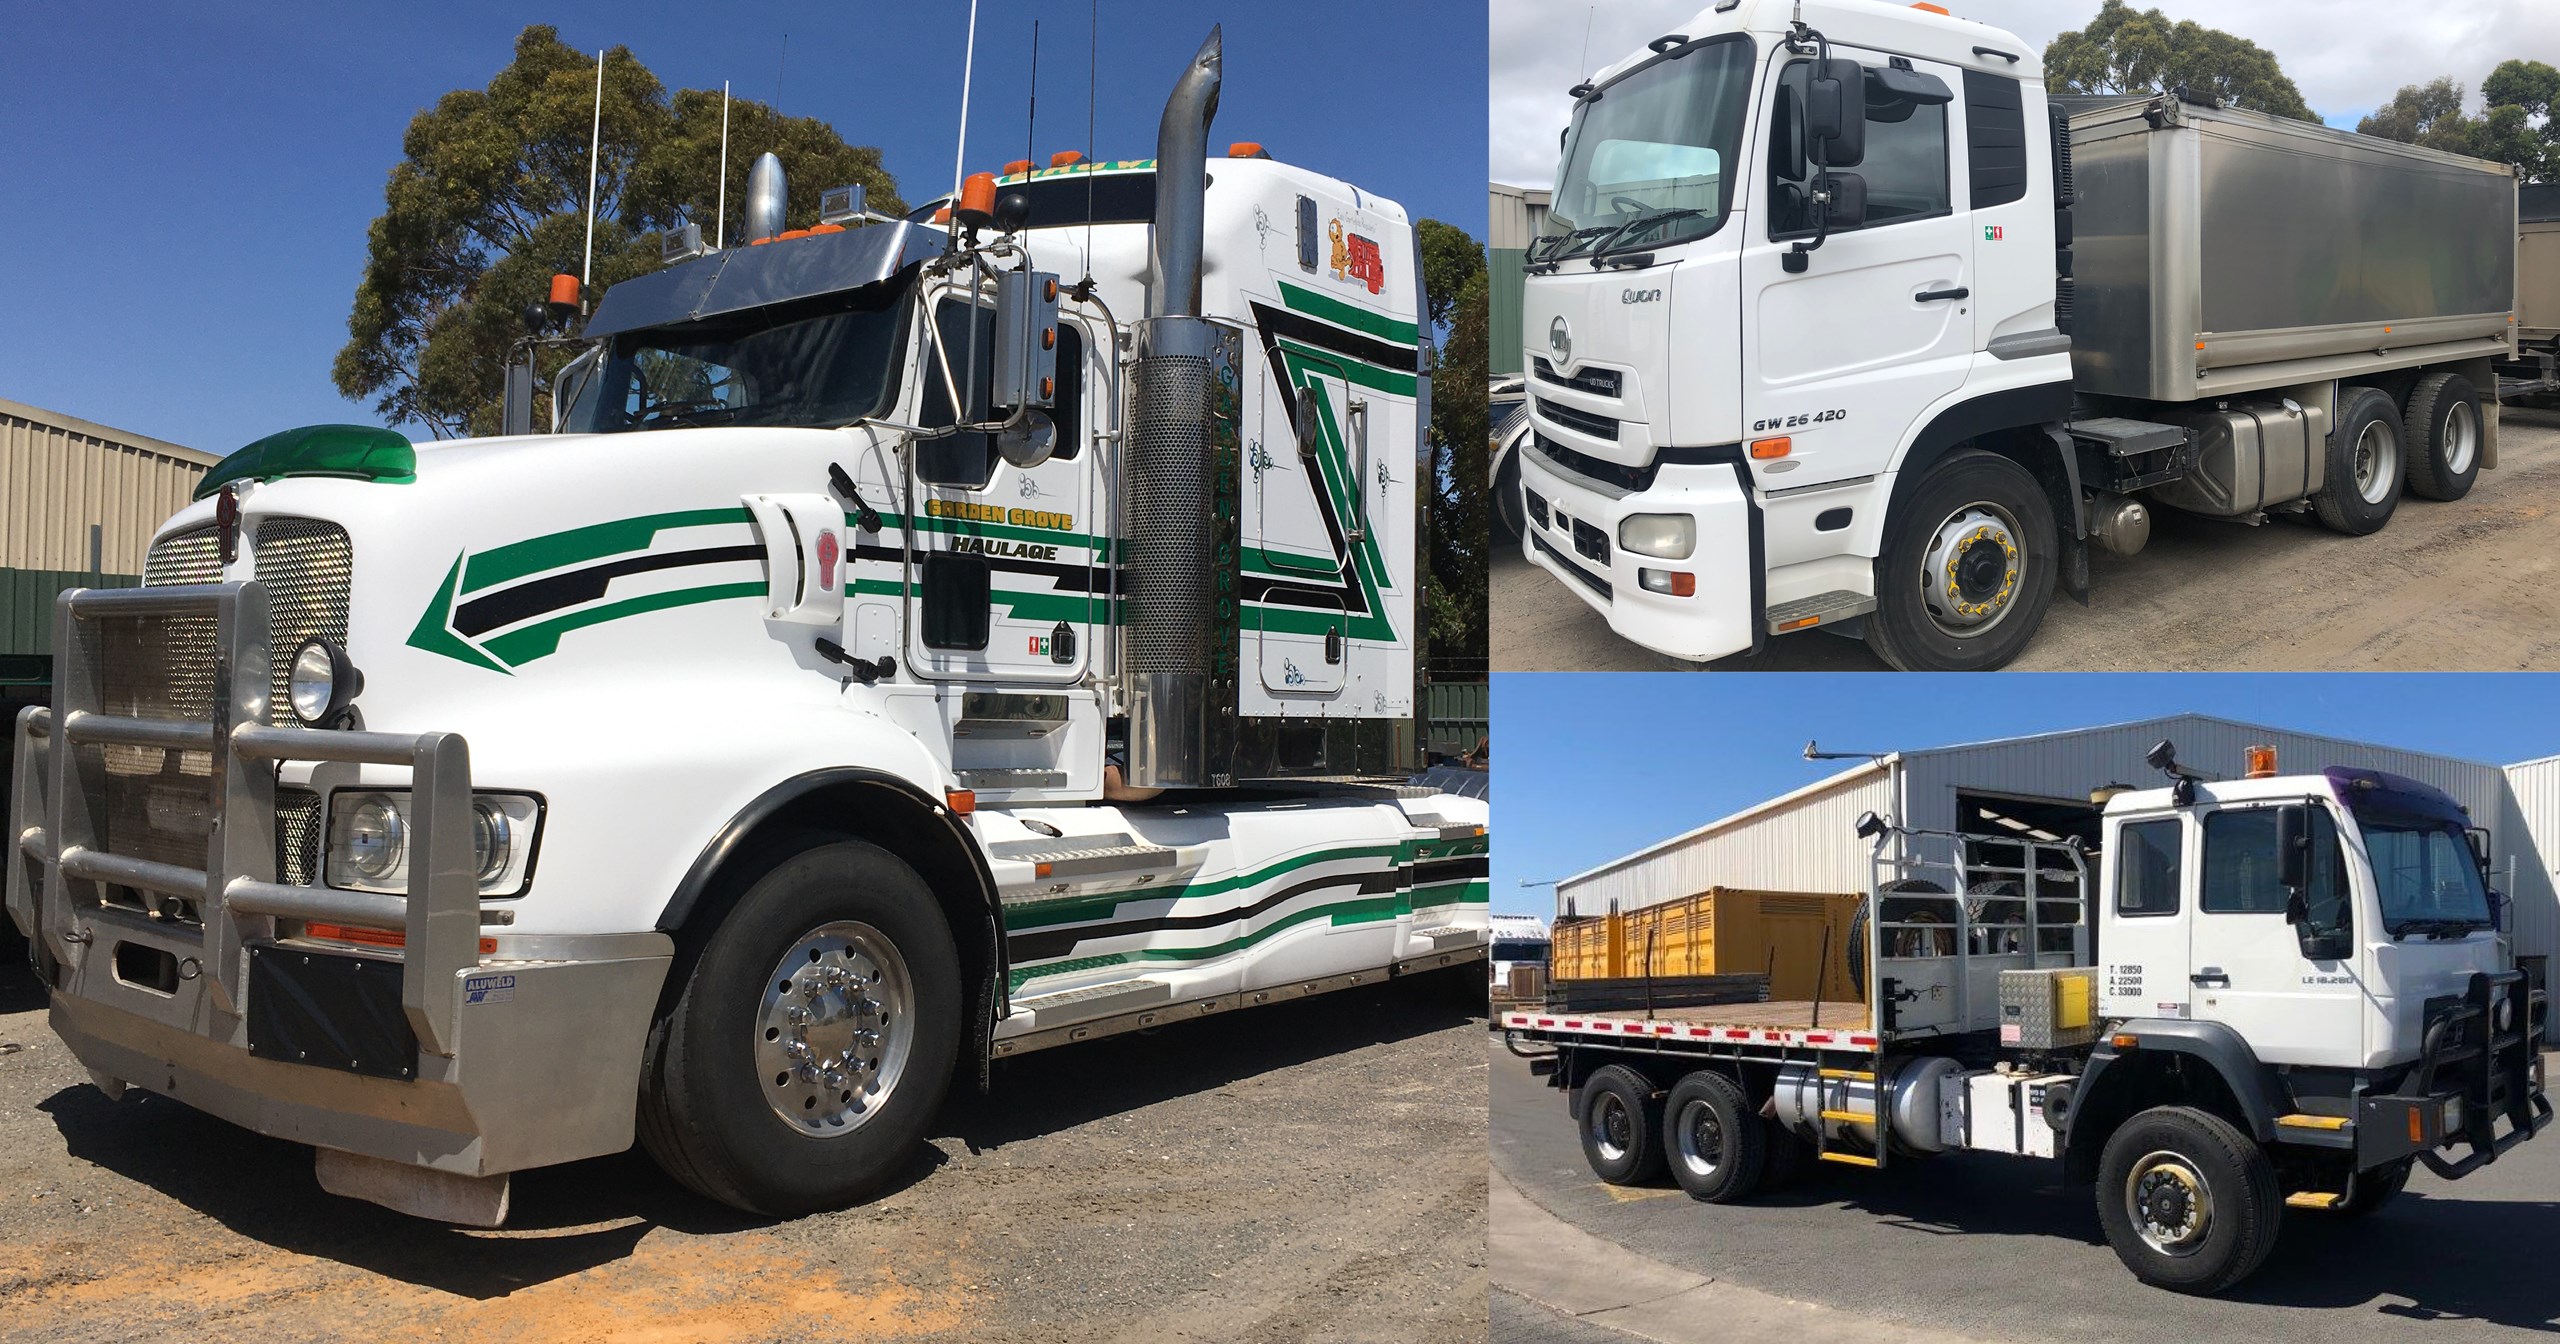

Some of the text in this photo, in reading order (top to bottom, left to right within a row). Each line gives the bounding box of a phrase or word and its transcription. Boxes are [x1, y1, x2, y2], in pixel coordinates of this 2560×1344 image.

[1622, 288, 1661, 304] Quon
[1597, 379, 1614, 389] TRUCKS
[1753, 409, 1847, 431] GW 26 420
[925, 500, 1073, 531] GARDEN GROVE
[1218, 365, 1232, 674] GARDEN GROVE
[1211, 773, 1231, 787] T608
[2120, 965, 2142, 974] 12850
[467, 977, 514, 991] ALUWELD
[2118, 976, 2142, 985] 22500
[2118, 987, 2142, 996] 33000
